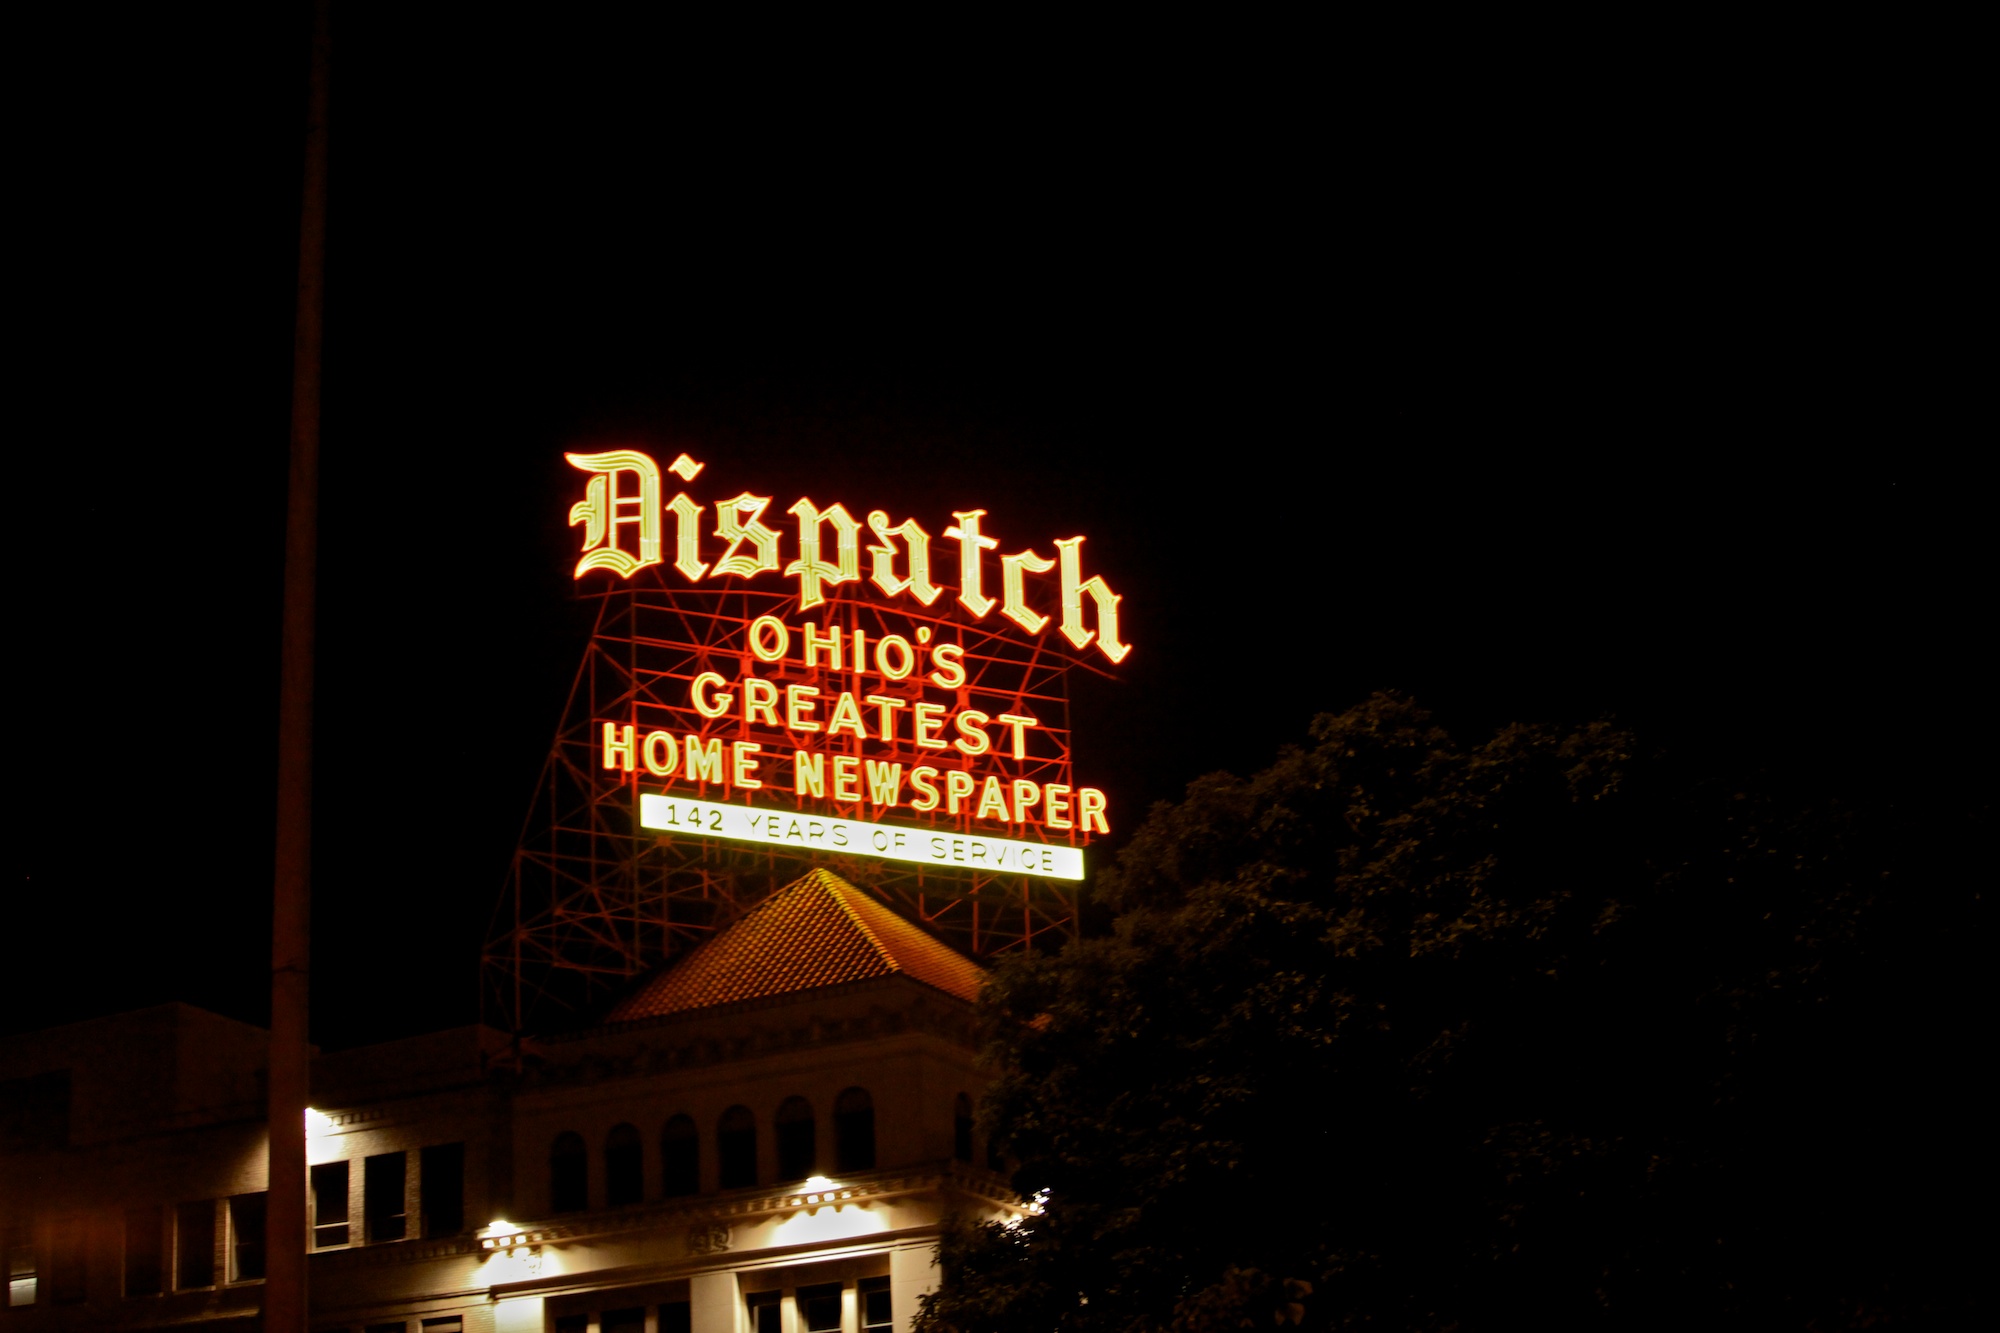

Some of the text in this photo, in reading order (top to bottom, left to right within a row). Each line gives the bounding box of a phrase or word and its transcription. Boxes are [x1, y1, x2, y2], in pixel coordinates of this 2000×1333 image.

[564, 449, 1132, 664] Dispatch
[749, 615, 966, 688] OHIO'S
[691, 671, 1037, 760] GREATEST
[603, 722, 1110, 834] HOME NEWSPAPER
[666, 803, 1055, 871] 142 YEARS OF SERVICE
